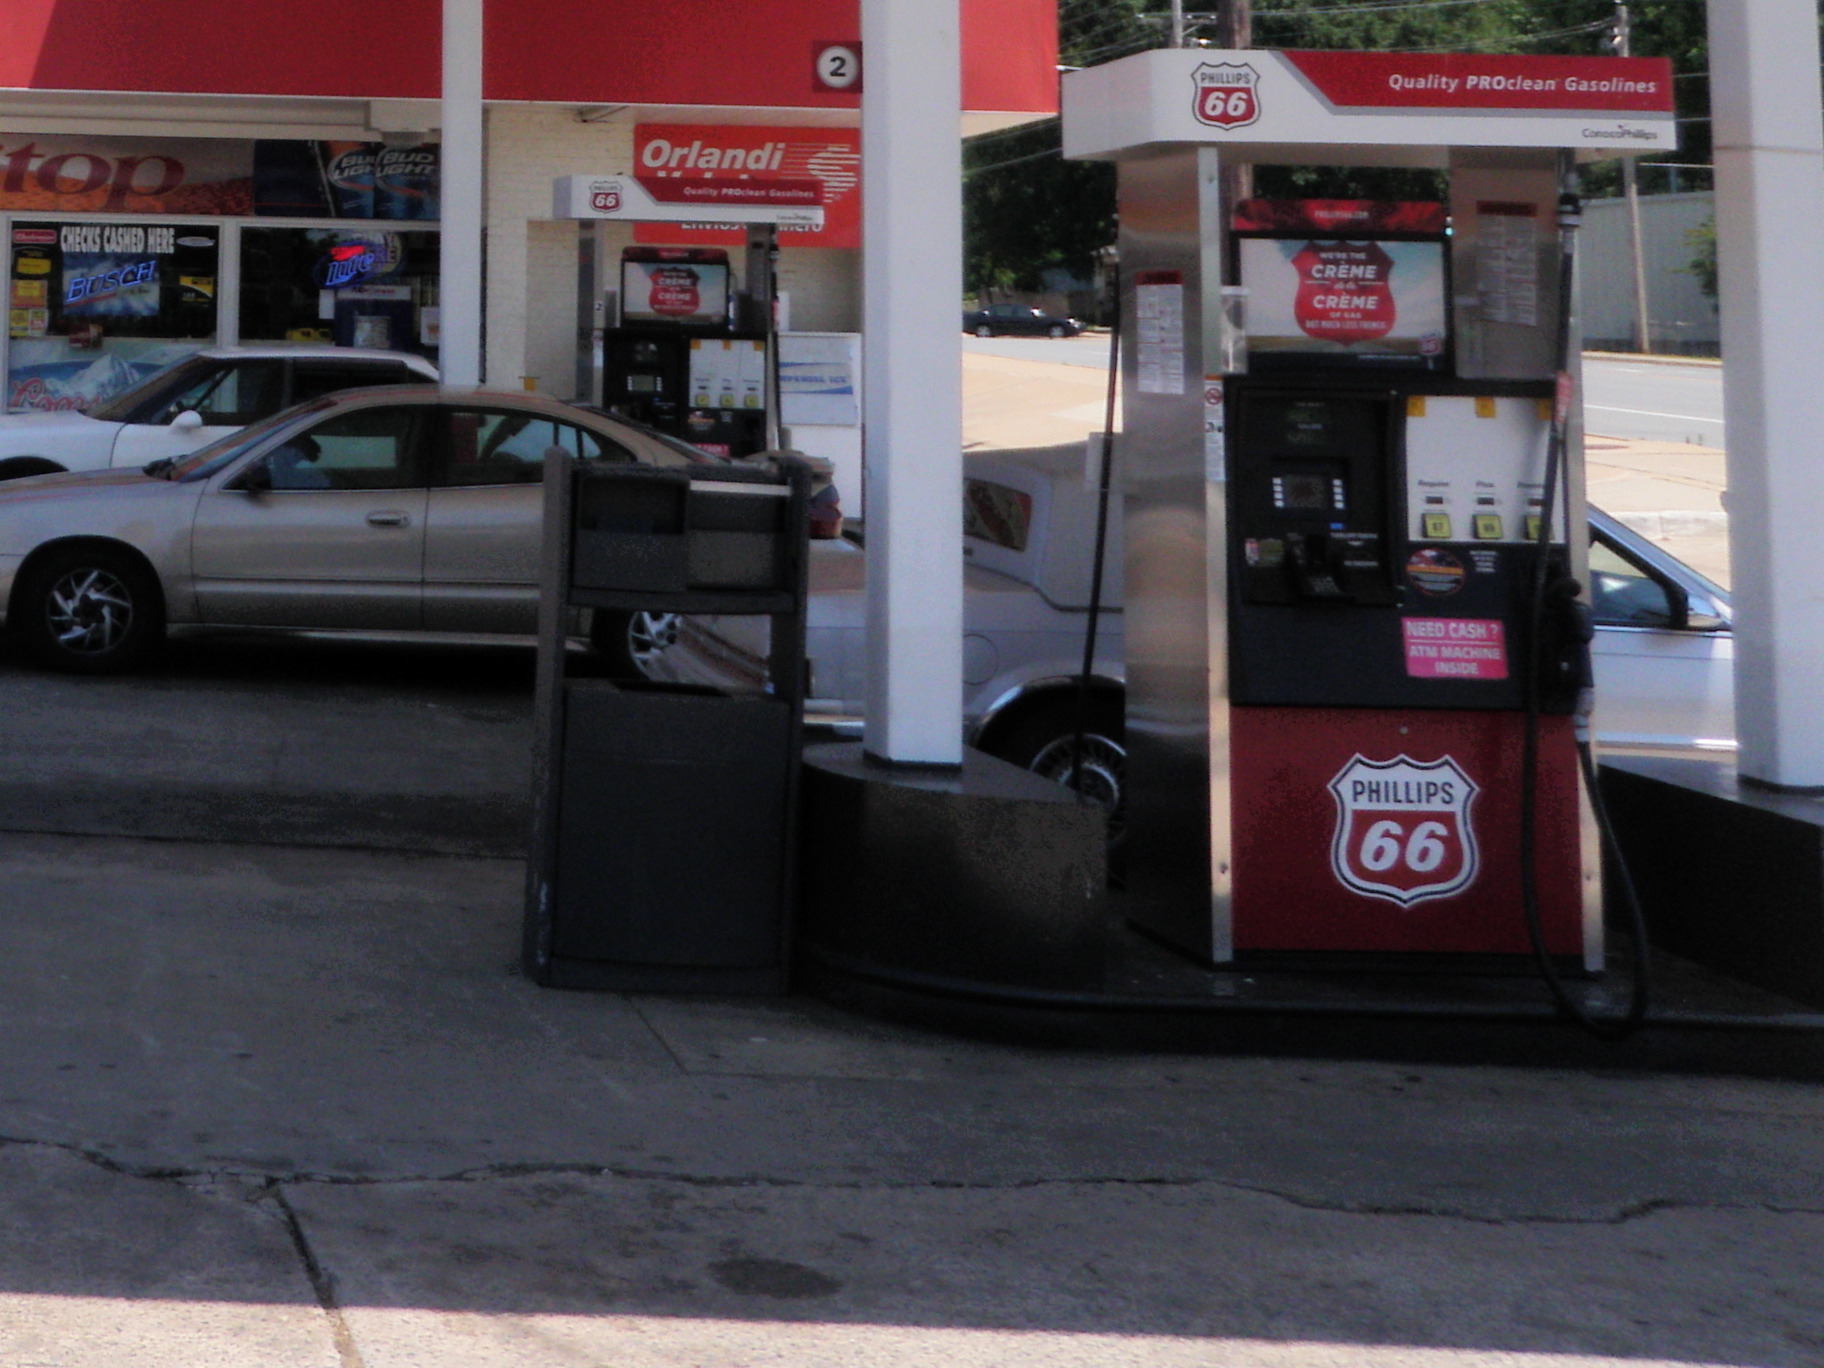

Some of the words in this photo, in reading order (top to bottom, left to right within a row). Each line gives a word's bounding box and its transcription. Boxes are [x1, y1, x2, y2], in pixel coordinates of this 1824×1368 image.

[829, 56, 846, 77] 2
[1201, 72, 1251, 85] PHILLIPS
[1389, 74, 1459, 93] Quality
[1466, 75, 1556, 91] PROclean
[1565, 77, 1657, 94] Gasolines
[1204, 91, 1248, 117] 66
[341, 155, 375, 168] BU
[642, 138, 786, 170] Orlandi
[595, 194, 617, 208] 66
[684, 186, 717, 197] Quality
[769, 189, 814, 198] Gasolines
[60, 226, 101, 253] CHECKS
[103, 227, 145, 254] CASHED
[148, 228, 175, 255] HERE
[65, 261, 157, 305] BUSCH
[1406, 621, 1444, 637] NEED
[1448, 622, 1487, 639] CASH
[1409, 645, 1438, 658] ATM
[1441, 646, 1501, 660] MACHINE
[1434, 662, 1478, 675] INSIDE
[1352, 780, 1455, 805] PHILLIPS
[1360, 820, 1449, 872] 66
